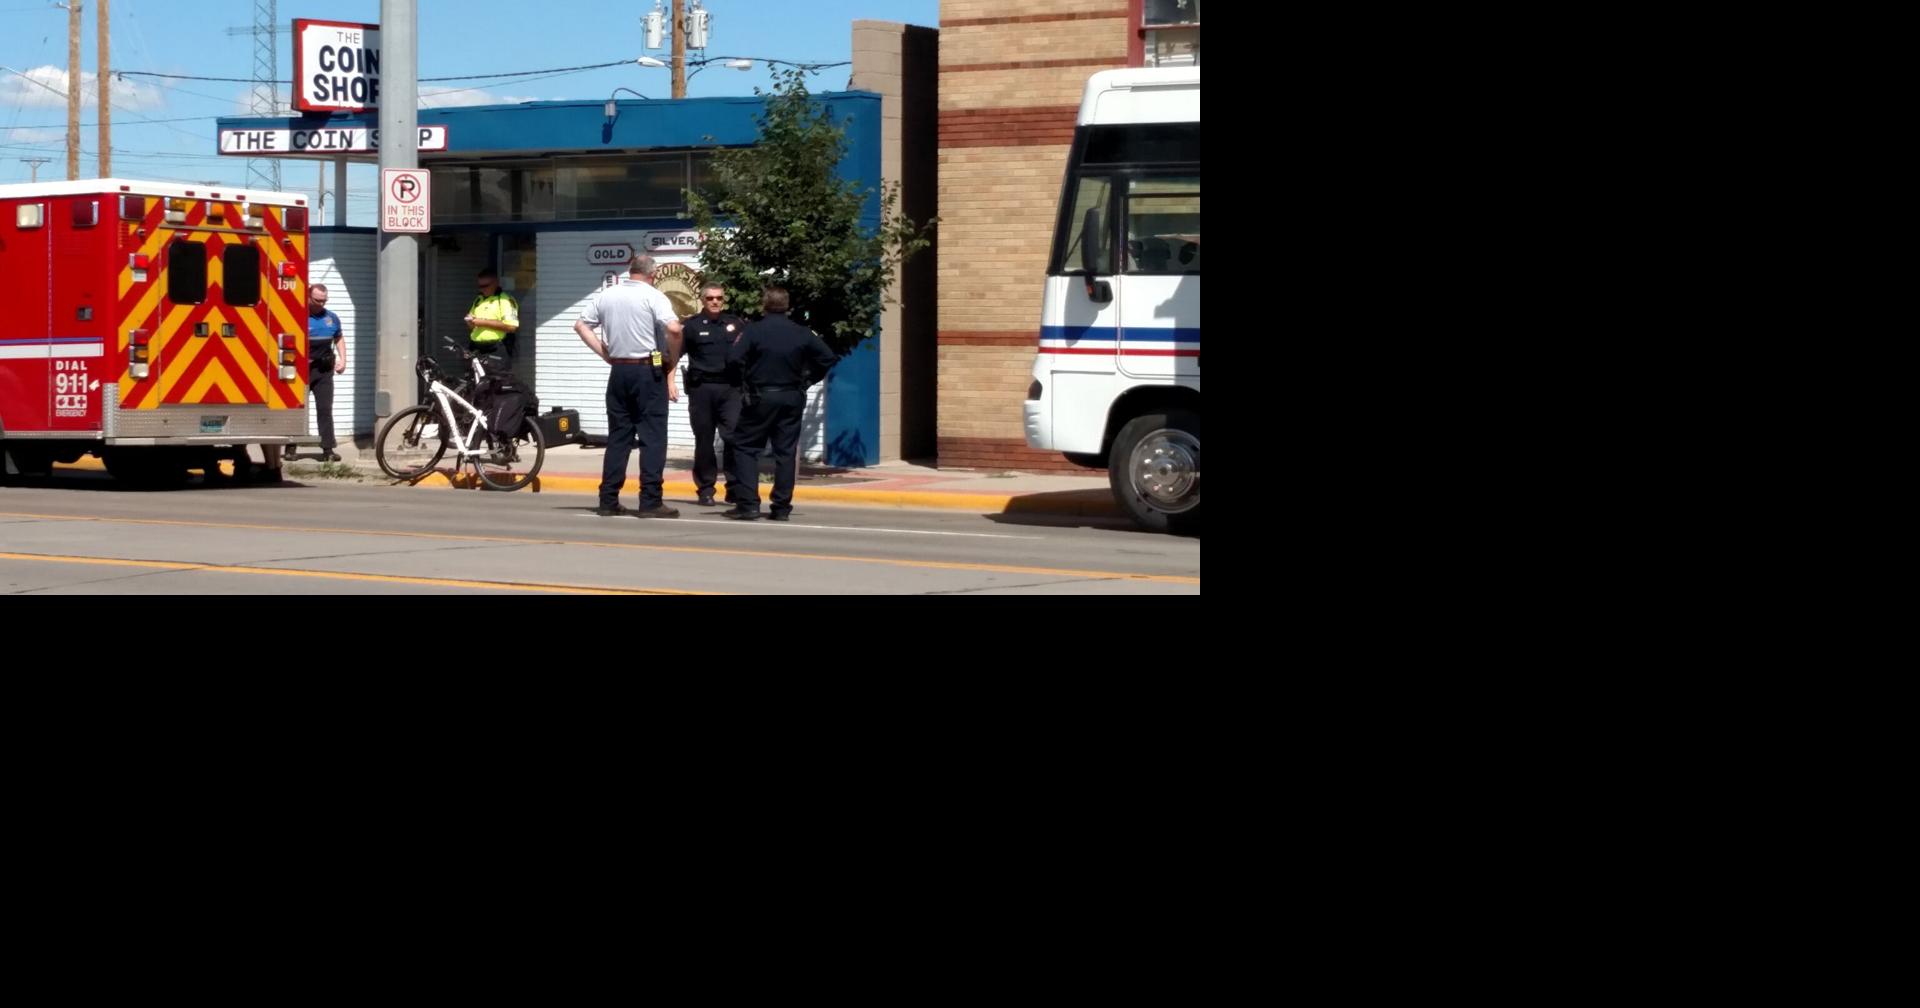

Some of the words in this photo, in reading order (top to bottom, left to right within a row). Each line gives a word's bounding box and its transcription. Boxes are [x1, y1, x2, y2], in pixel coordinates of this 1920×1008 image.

[336, 31, 361, 44] THE
[319, 44, 380, 74] COIN
[232, 131, 276, 149] THE
[293, 129, 354, 149] COIN
[387, 205, 399, 216] IN
[401, 205, 425, 216] THIS
[388, 216, 424, 228] BLOCK
[651, 236, 696, 246] SILVER
[594, 249, 625, 260] GOLD
[56, 360, 88, 371] DIAL
